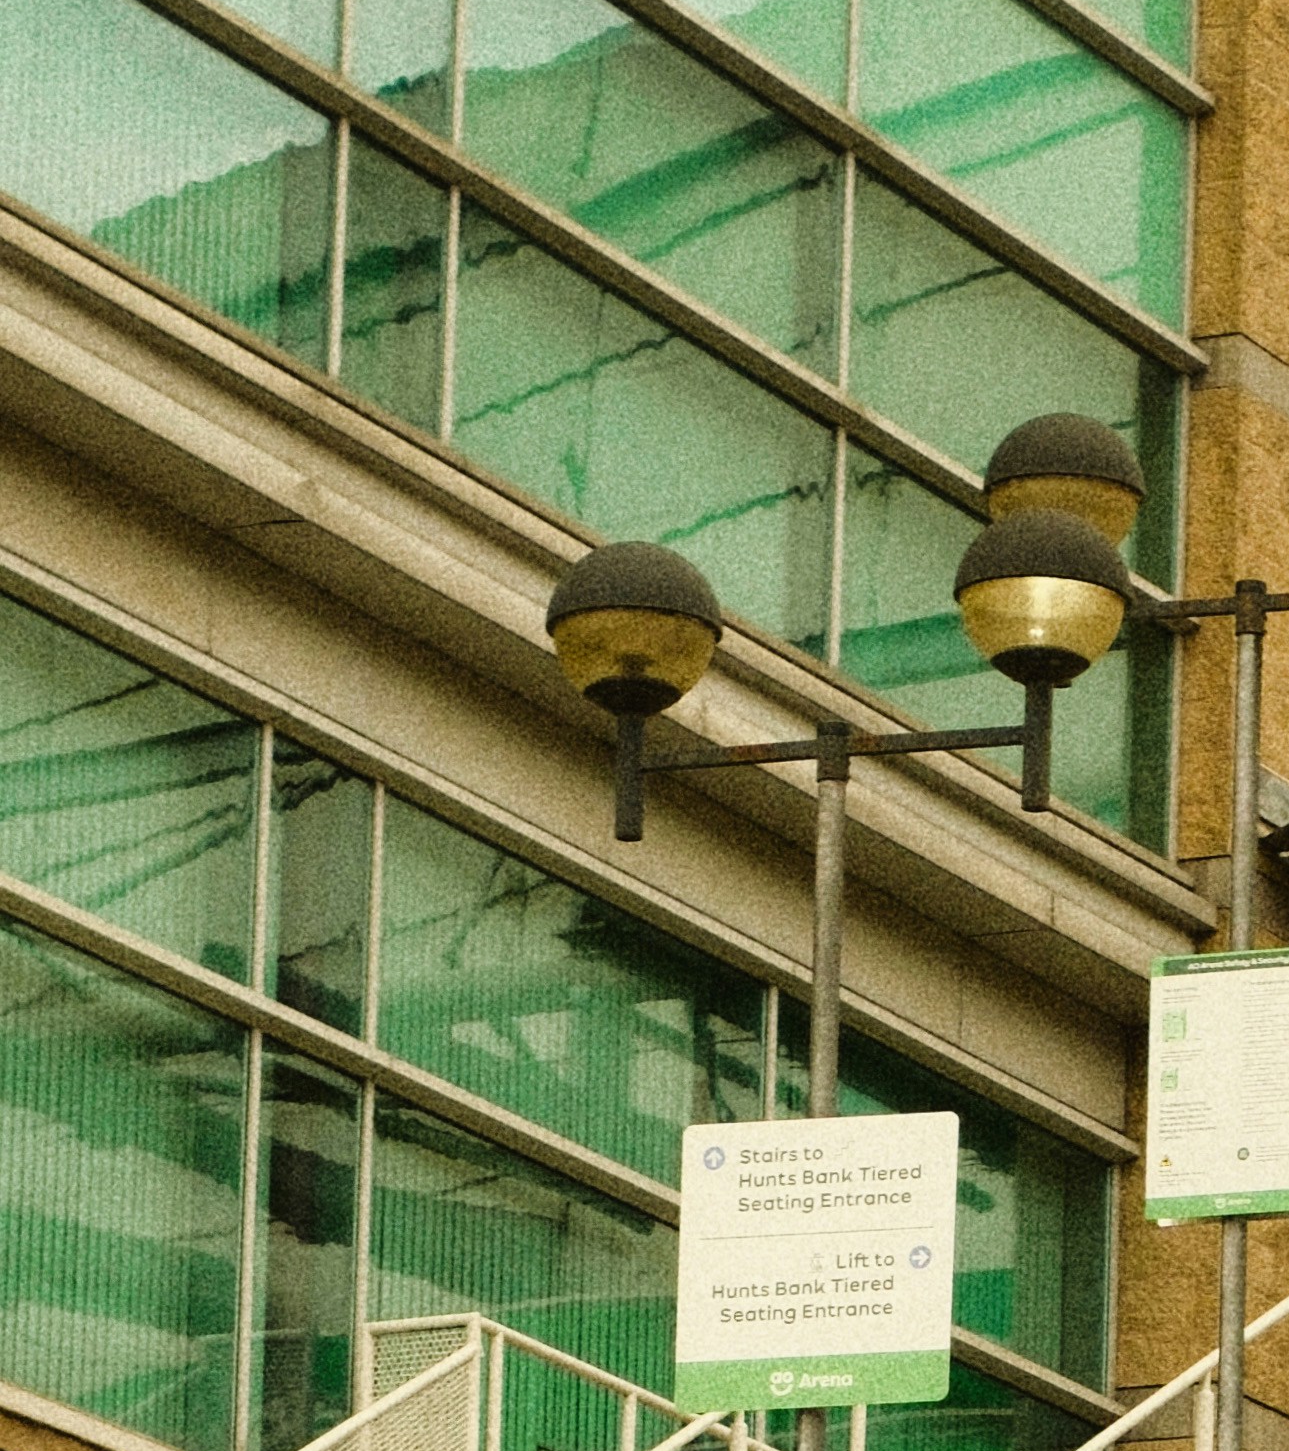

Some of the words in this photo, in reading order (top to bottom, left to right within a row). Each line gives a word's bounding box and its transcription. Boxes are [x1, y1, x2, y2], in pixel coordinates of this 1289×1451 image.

[739, 1148, 798, 1165] Stairs
[803, 1148, 824, 1161] to
[738, 1171, 797, 1188] Hunts
[802, 1167, 853, 1185] Bank
[858, 1164, 922, 1182] Tiered
[738, 1194, 814, 1213] Seating
[820, 1190, 912, 1208] Entrance
[836, 1252, 871, 1269] Lift
[874, 1253, 895, 1267] to
[711, 1283, 770, 1299] Hunts
[775, 1278, 826, 1296] Bank
[831, 1275, 895, 1293] Tiered
[720, 1305, 797, 1324] Seating
[802, 1302, 894, 1319] Entrance
[799, 1373, 854, 1388] Arena
